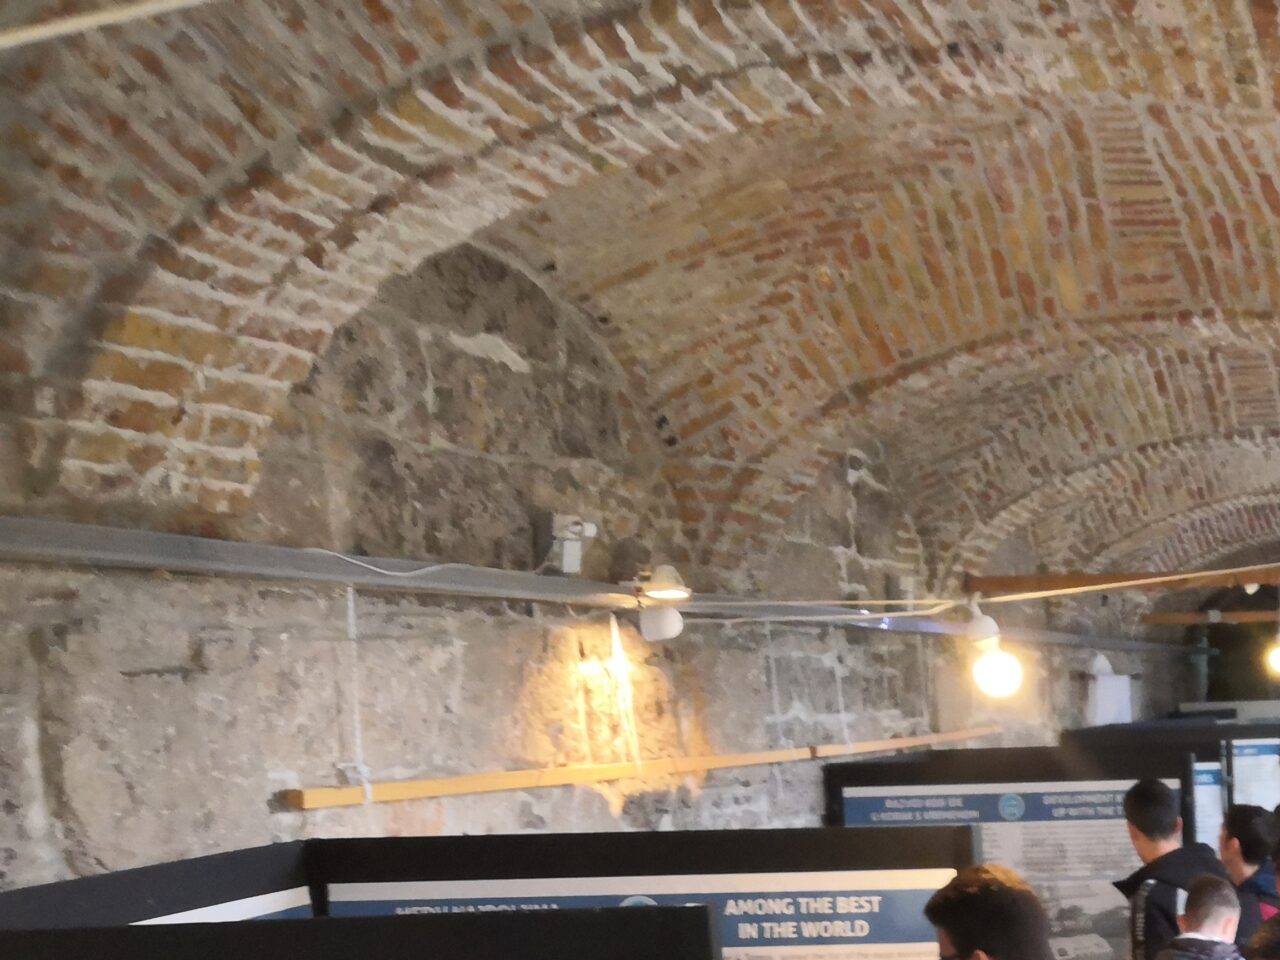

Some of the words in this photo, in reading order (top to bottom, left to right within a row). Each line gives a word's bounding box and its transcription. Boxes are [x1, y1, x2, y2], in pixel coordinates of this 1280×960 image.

[724, 898, 795, 916] AMONG
[797, 897, 834, 914] THE
[836, 896, 882, 914] BEST
[738, 922, 758, 939] IN
[761, 922, 798, 938] THE
[800, 919, 870, 938] WORLD
